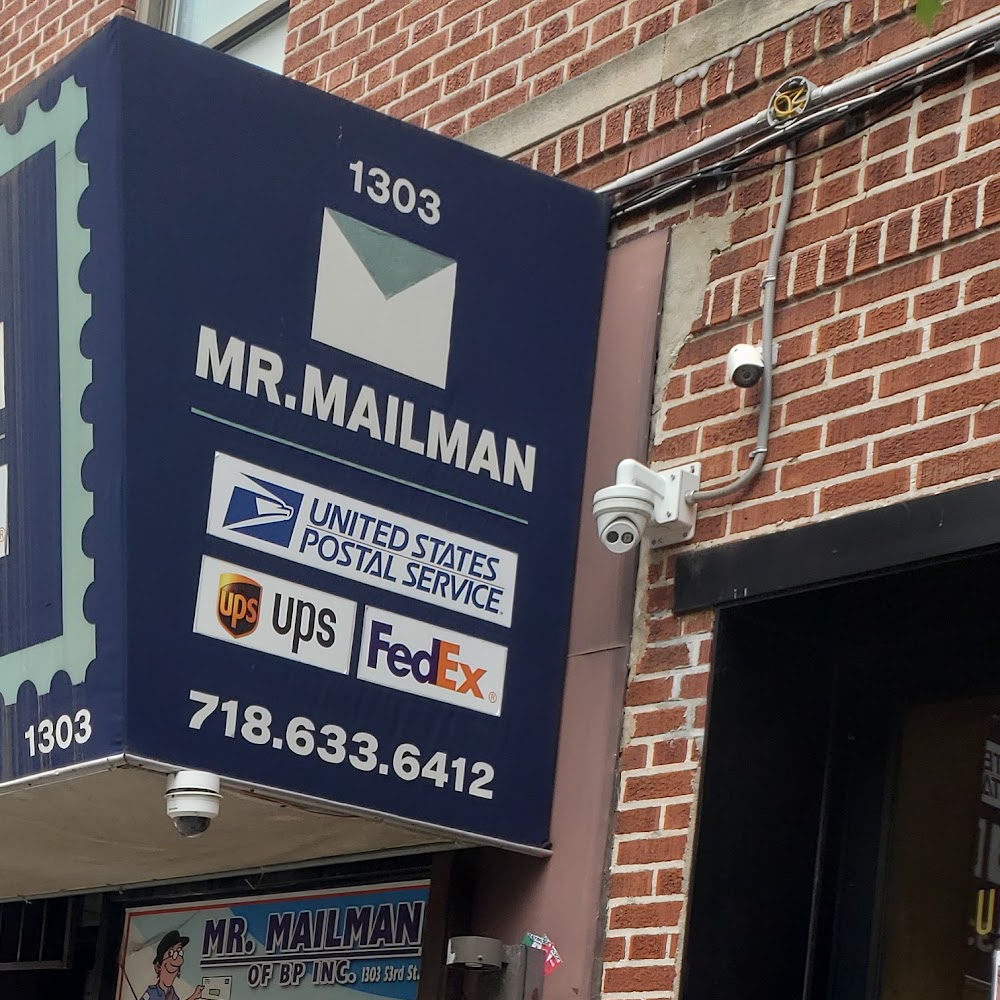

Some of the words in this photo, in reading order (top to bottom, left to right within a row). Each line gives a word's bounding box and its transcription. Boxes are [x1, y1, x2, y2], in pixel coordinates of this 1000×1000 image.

[349, 159, 441, 226] 1303
[299, 528, 396, 582] POSTAL
[402, 562, 503, 614] SERVICE
[309, 498, 409, 552] UNITED
[412, 533, 500, 581] STATES
[218, 588, 258, 628] ups
[272, 592, 337, 653] ups
[367, 621, 487, 700] FedEx
[25, 708, 92, 758] 1303
[188, 690, 495, 800] 718.633.6412
[202, 915, 255, 957] MR.
[266, 901, 425, 955] MAILMAN
[248, 961, 273, 987] OF
[279, 961, 305, 986] BP
[312, 959, 356, 985] INC.
[361, 966, 381, 982] 1303
[384, 965, 405, 981] 53rd
